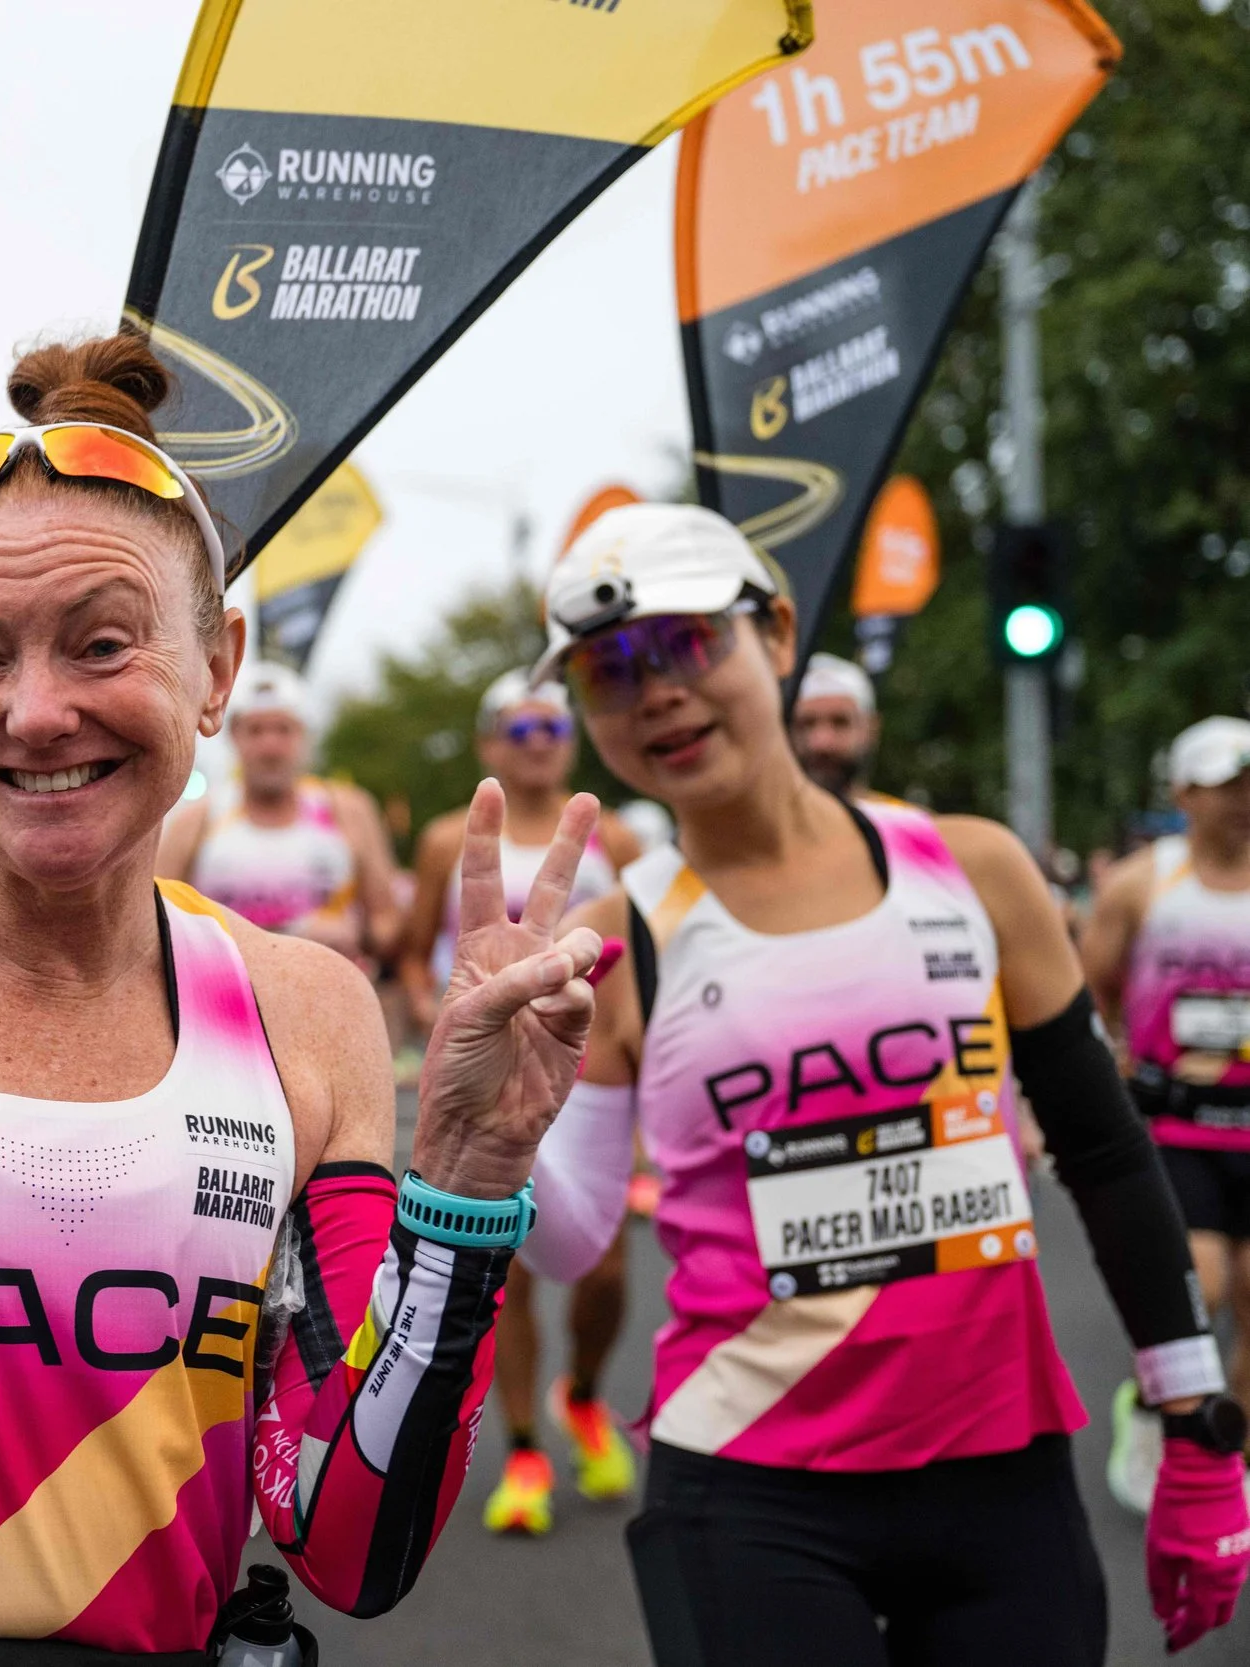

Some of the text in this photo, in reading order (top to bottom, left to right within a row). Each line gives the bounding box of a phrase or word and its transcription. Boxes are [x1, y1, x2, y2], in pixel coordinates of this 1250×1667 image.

[752, 22, 1031, 146] 1h 55m
[796, 94, 980, 194] PACE TEAM
[278, 149, 436, 188] RUNNING
[278, 186, 432, 205] WAREHOUSE
[281, 245, 421, 283] BALLARAT
[270, 283, 422, 321] MARATHON
[705, 1016, 998, 1132] PACE
[185, 1114, 276, 1145] RUNNING
[189, 1134, 276, 1155] WAREHOUSE
[197, 1166, 275, 1203] BALLARAT
[864, 1160, 923, 1201] 7407
[193, 1191, 276, 1230] MARATHON
[781, 1181, 1013, 1257] PACER MAD RABBIT
[400, 1305, 417, 1333] THE
[389, 1341, 404, 1362] WE
